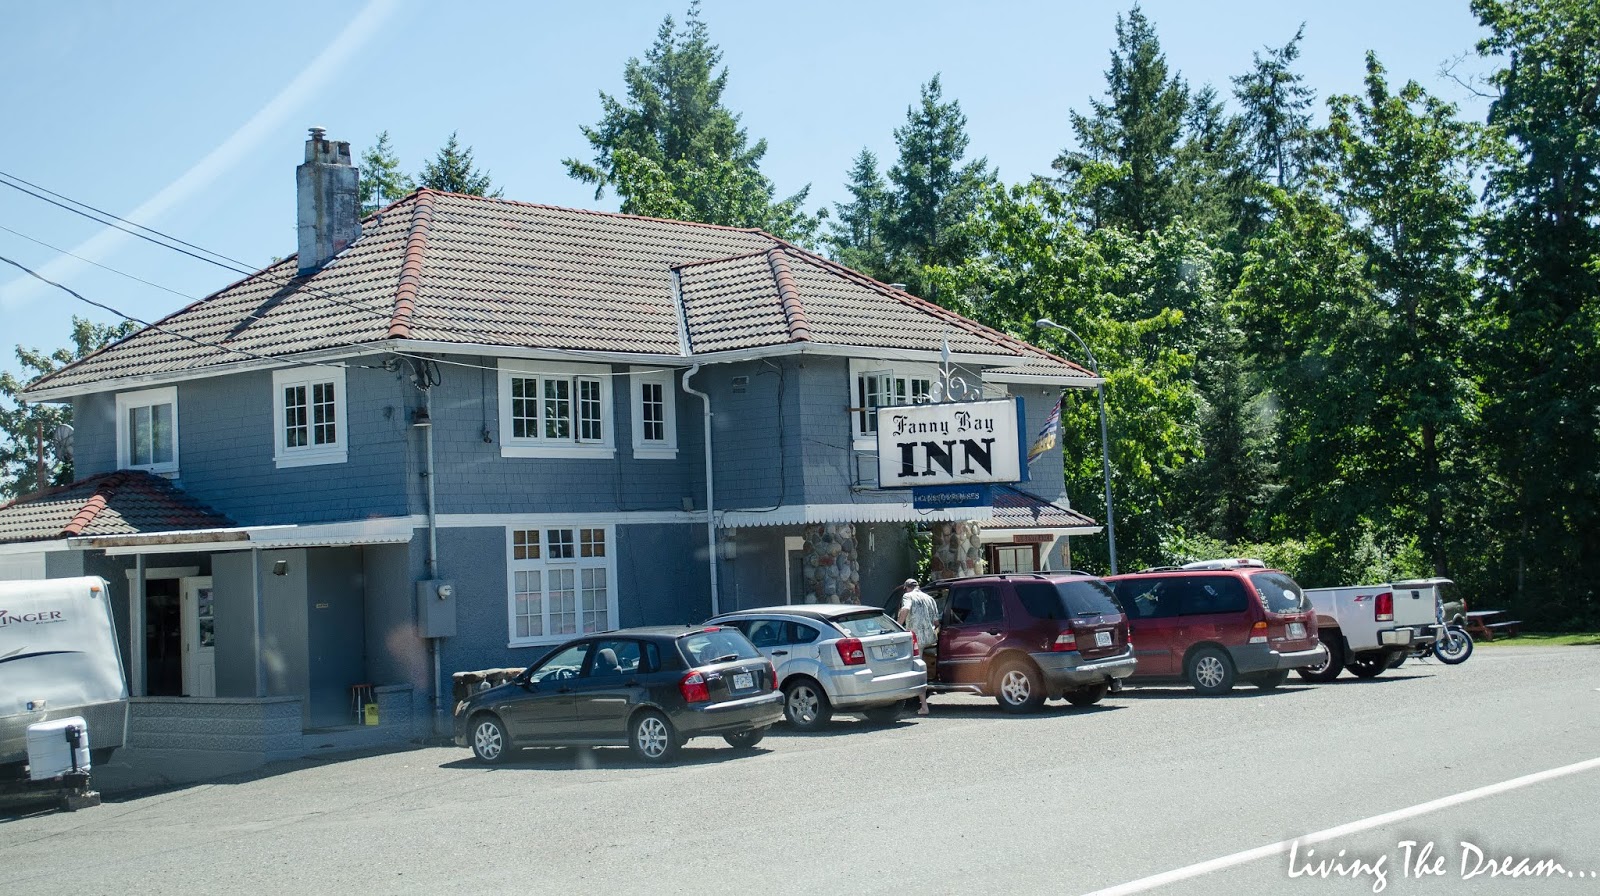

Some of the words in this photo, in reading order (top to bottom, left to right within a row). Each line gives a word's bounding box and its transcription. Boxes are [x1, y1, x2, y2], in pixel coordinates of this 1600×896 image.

[892, 415, 949, 437] Fanny
[954, 410, 995, 433] Bay
[896, 437, 996, 478] INN
